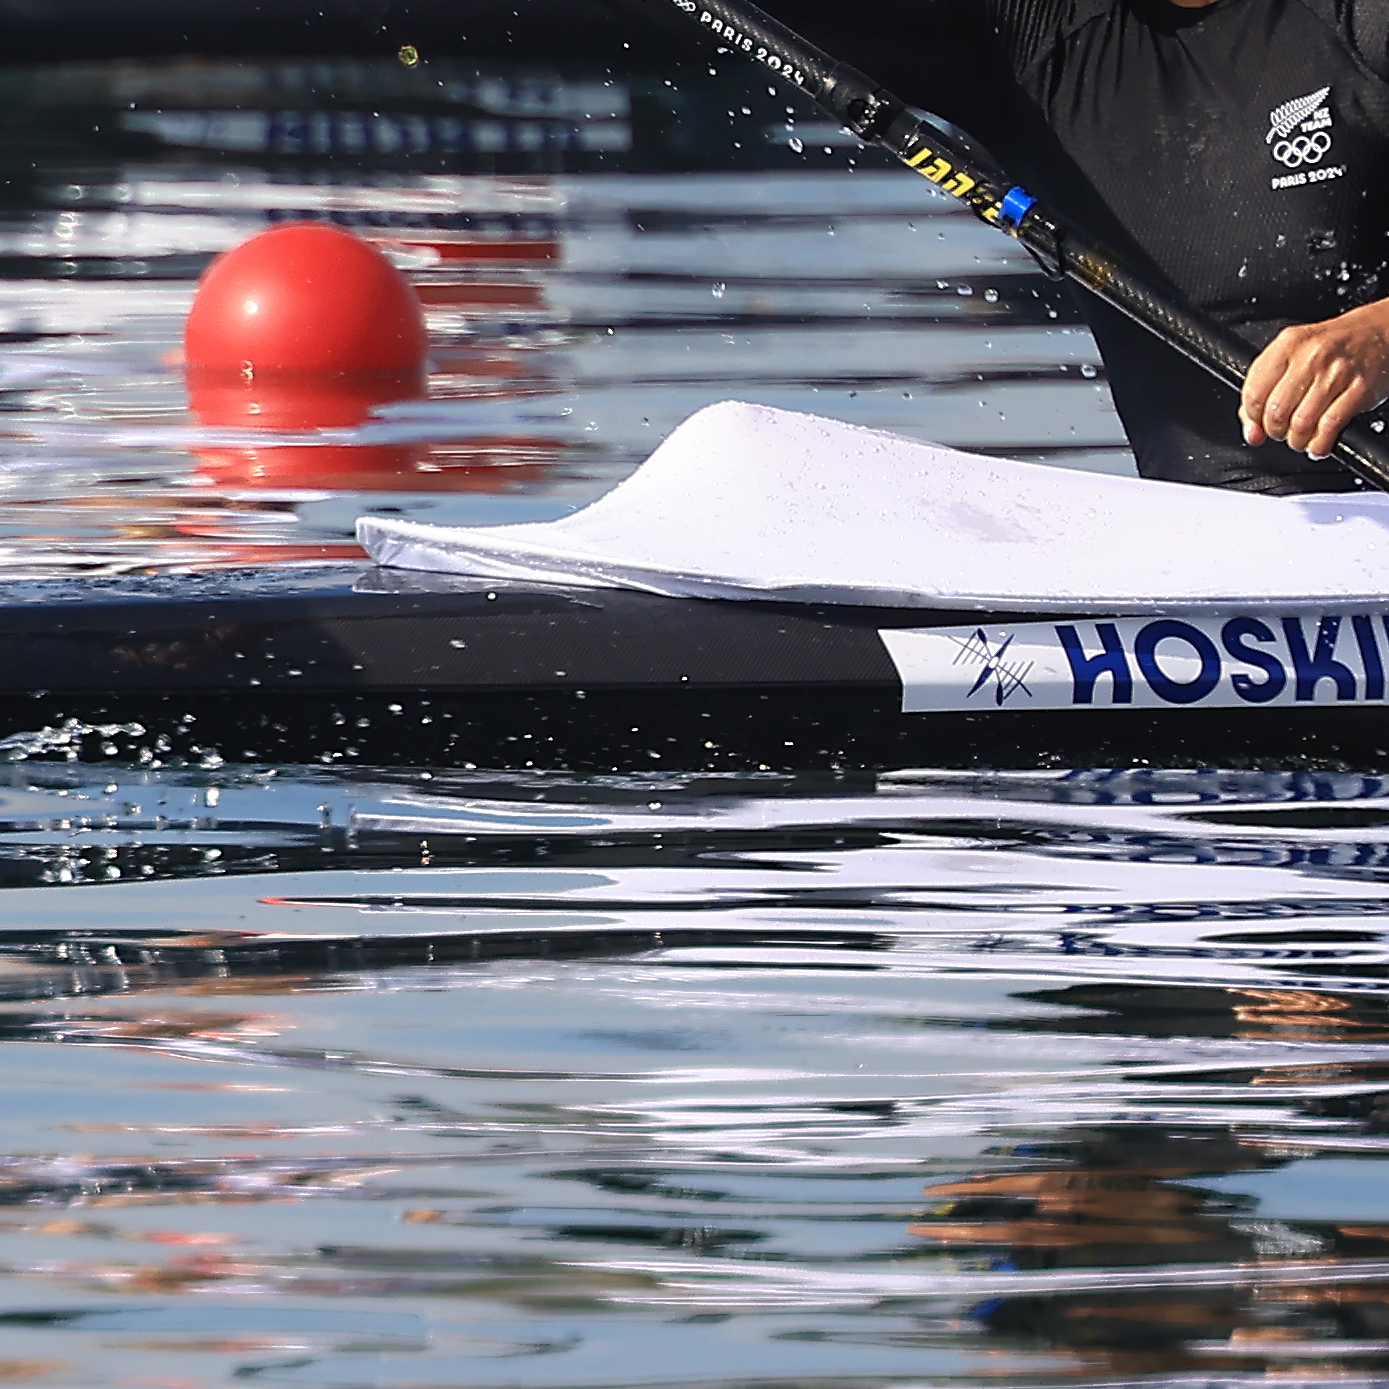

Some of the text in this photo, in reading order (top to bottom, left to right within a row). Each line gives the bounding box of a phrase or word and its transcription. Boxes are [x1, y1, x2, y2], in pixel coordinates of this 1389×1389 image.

[700, 11, 806, 87] PARIS 2024
[1301, 118, 1333, 133] TEAM
[1271, 164, 1348, 190] PARIS 2024
[1054, 615, 1389, 705] HOSKI
